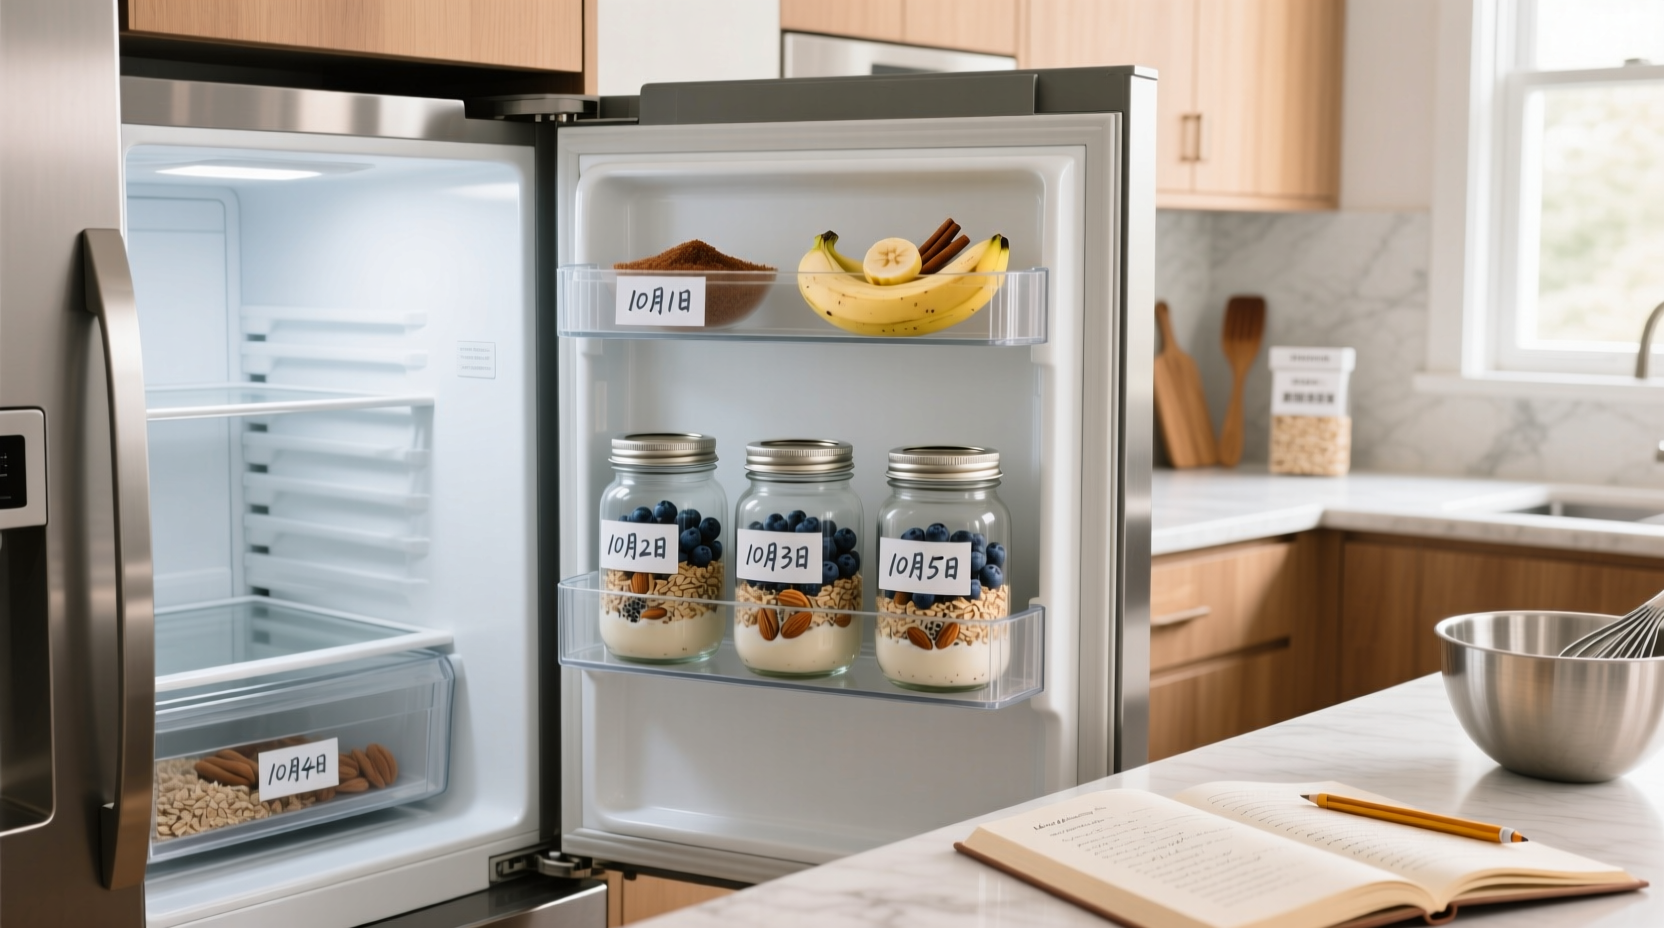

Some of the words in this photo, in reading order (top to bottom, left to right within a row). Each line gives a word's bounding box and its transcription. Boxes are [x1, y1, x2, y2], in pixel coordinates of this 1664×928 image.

[628, 286, 691, 315] 10月1日
[607, 532, 667, 561] 10月2日
[745, 542, 809, 572] 10月3日
[888, 551, 959, 582] 10月5日
[268, 753, 327, 786] 10月4日
